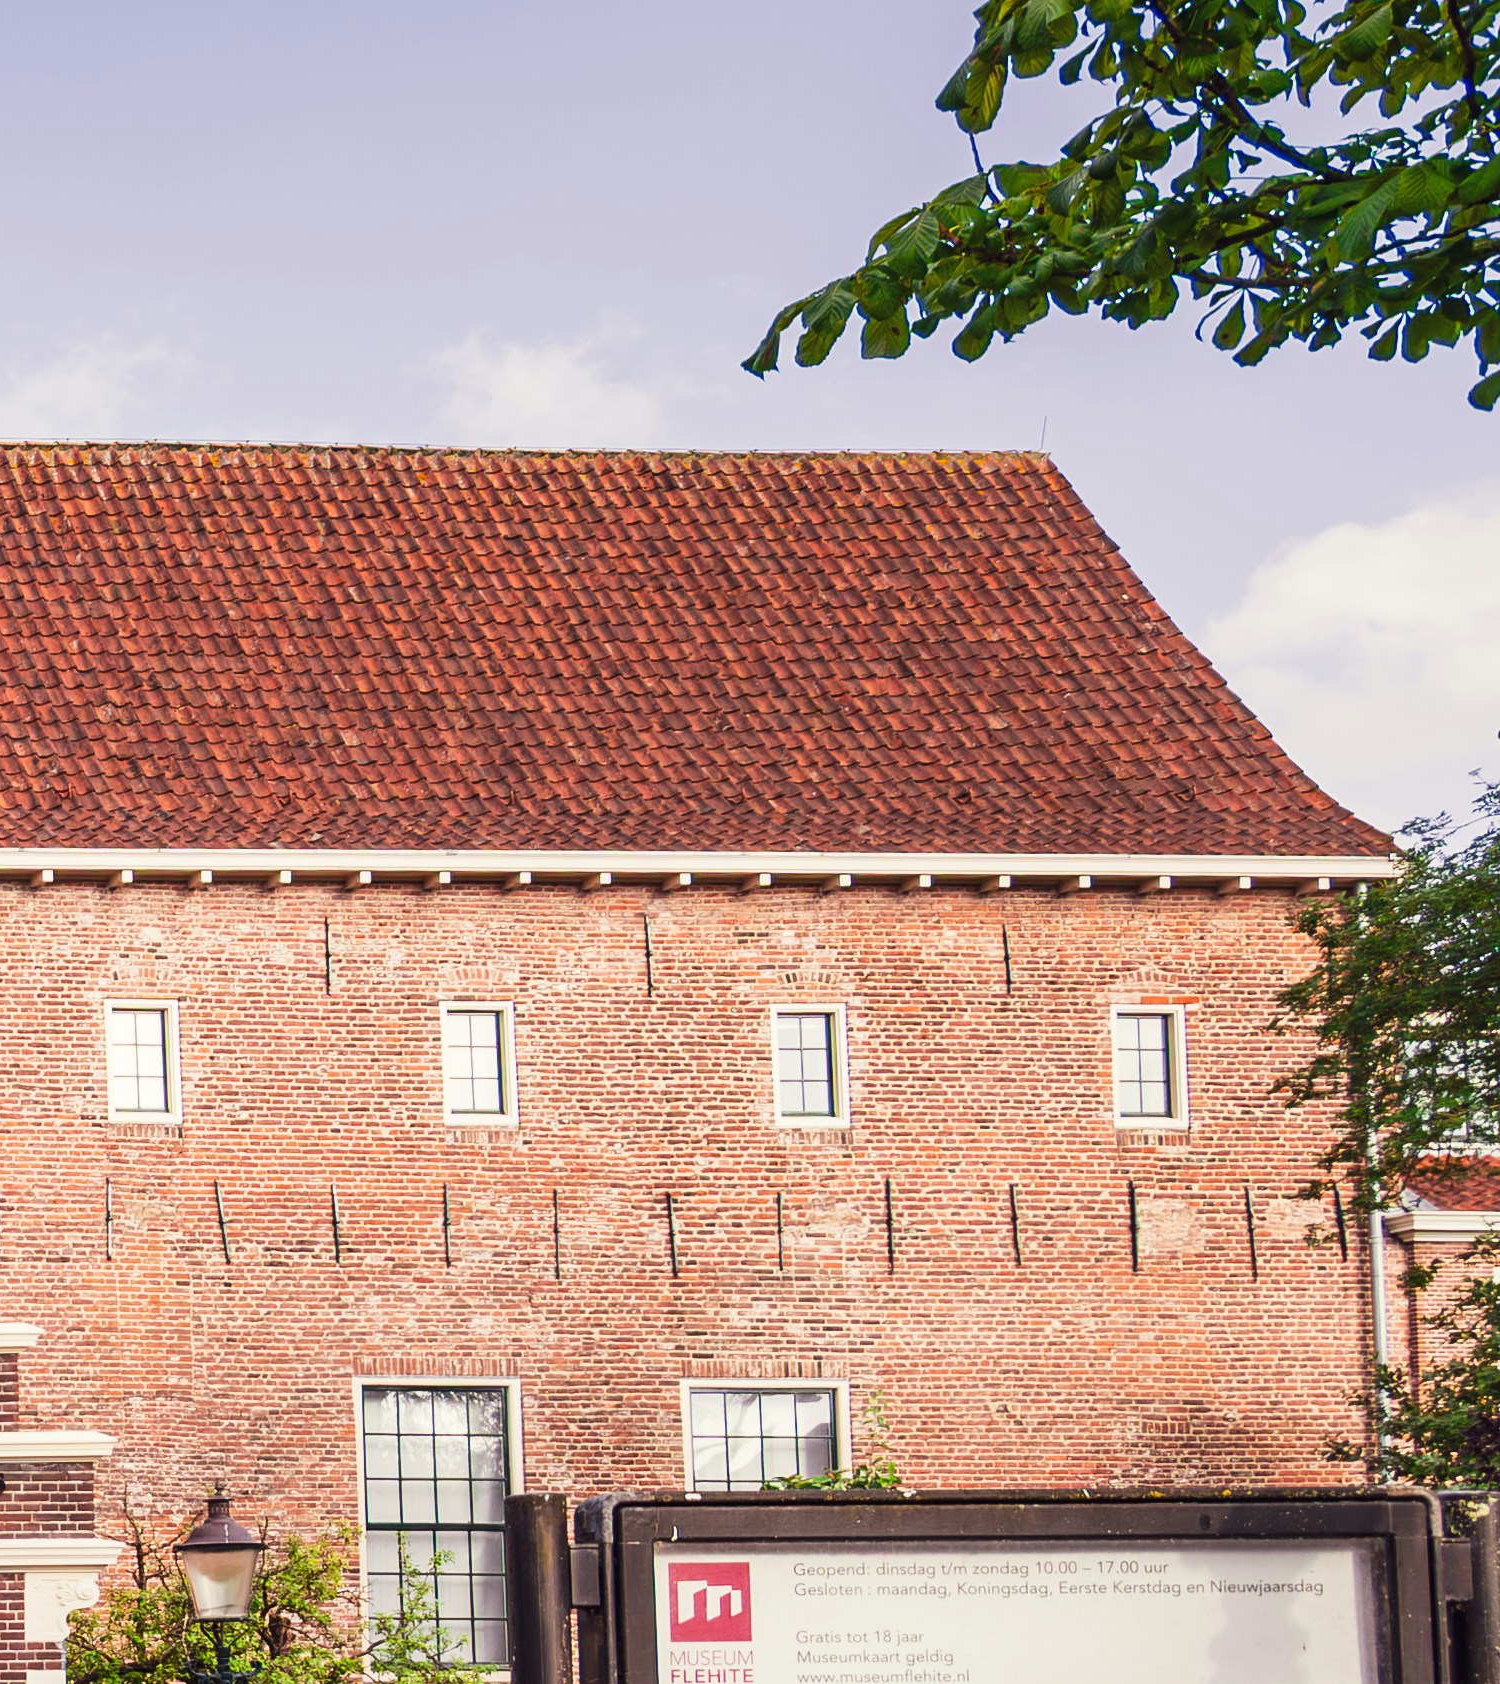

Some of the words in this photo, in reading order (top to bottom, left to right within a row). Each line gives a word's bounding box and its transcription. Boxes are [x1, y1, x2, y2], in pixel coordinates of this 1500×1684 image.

[793, 1562, 870, 1579] Geopend:
[876, 1562, 936, 1578] dinsdag
[941, 1562, 967, 1576] t/m
[972, 1562, 1029, 1578] zondag
[1035, 1561, 1078, 1574] 10.00
[1097, 1561, 1139, 1574] 17.00
[1144, 1563, 1168, 1573] uur
[794, 1582, 863, 1596] Gesloten
[877, 1582, 952, 1598] maandag,
[957, 1582, 1053, 1598] Koningsdag,
[1059, 1581, 1107, 1594] Eerste
[1113, 1580, 1181, 1597] Kerstdag
[1187, 1584, 1205, 1593] en
[1210, 1580, 1324, 1596] Nieuwjaarsdag
[796, 1630, 841, 1644] Gratis
[847, 1631, 868, 1643] tot
[875, 1630, 892, 1643] 18
[895, 1631, 924, 1647] jaar
[670, 1650, 754, 1666] MUSEUM
[797, 1650, 900, 1664] Museumkaart
[906, 1649, 954, 1667] geldig
[670, 1668, 754, 1683] FLEHITE
[797, 1669, 971, 1684] www.museumflehite.nl
